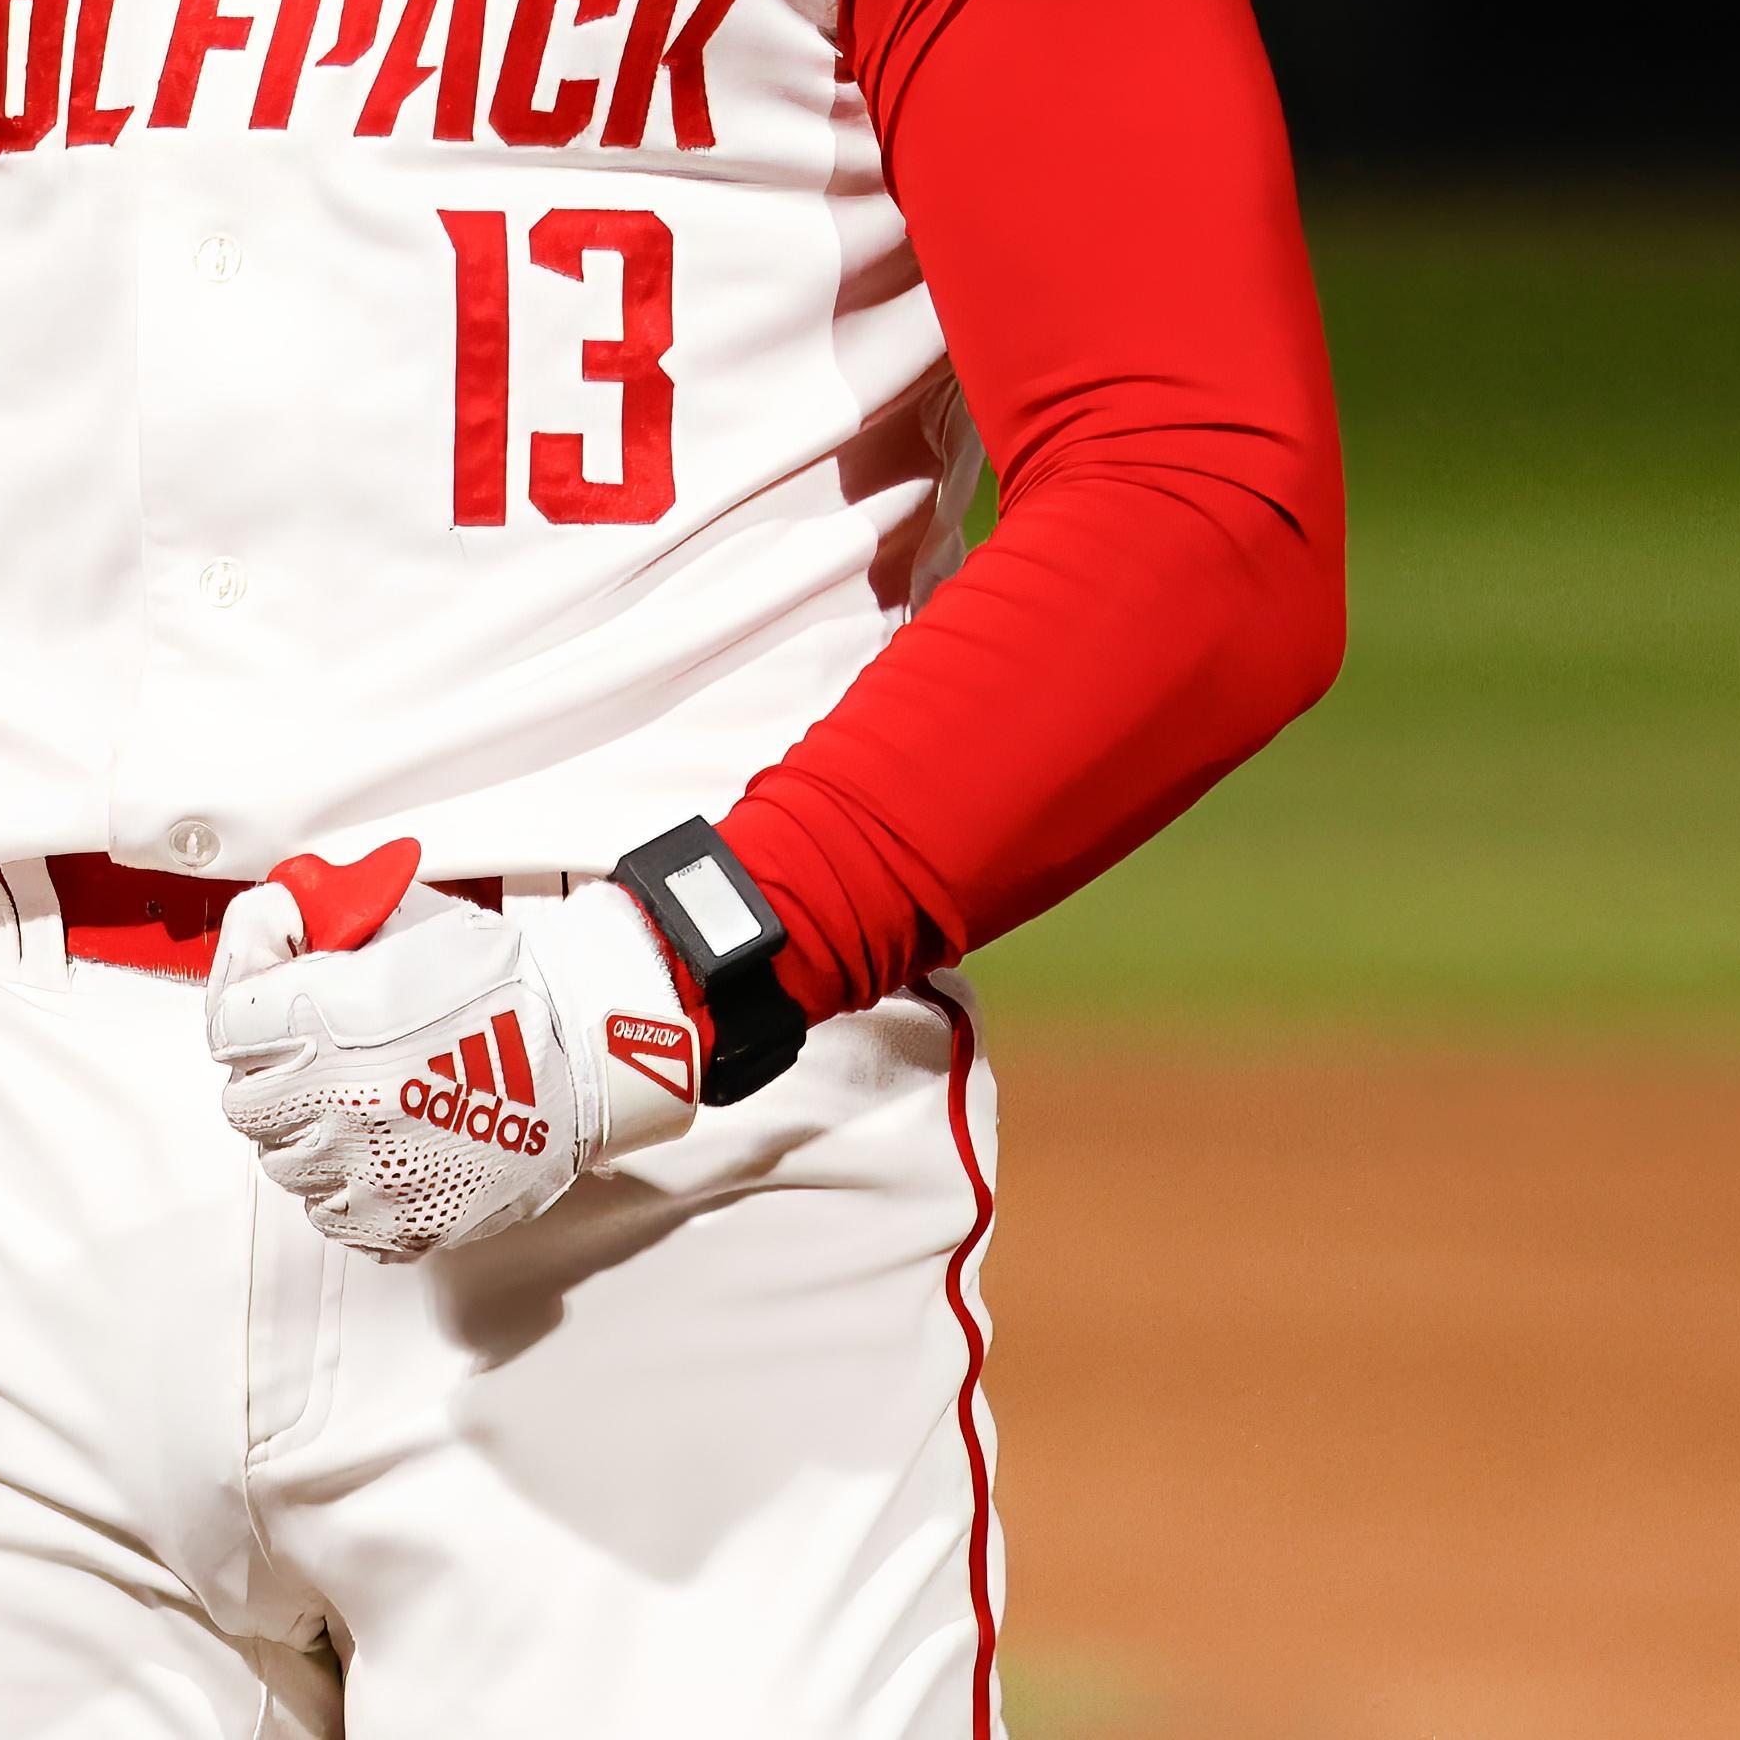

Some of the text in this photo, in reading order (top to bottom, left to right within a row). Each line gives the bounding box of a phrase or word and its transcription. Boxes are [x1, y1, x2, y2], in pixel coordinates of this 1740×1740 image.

[436, 208, 675, 527] 13
[613, 1020, 683, 1048] ADIZERO
[401, 1078, 549, 1156] adidas
